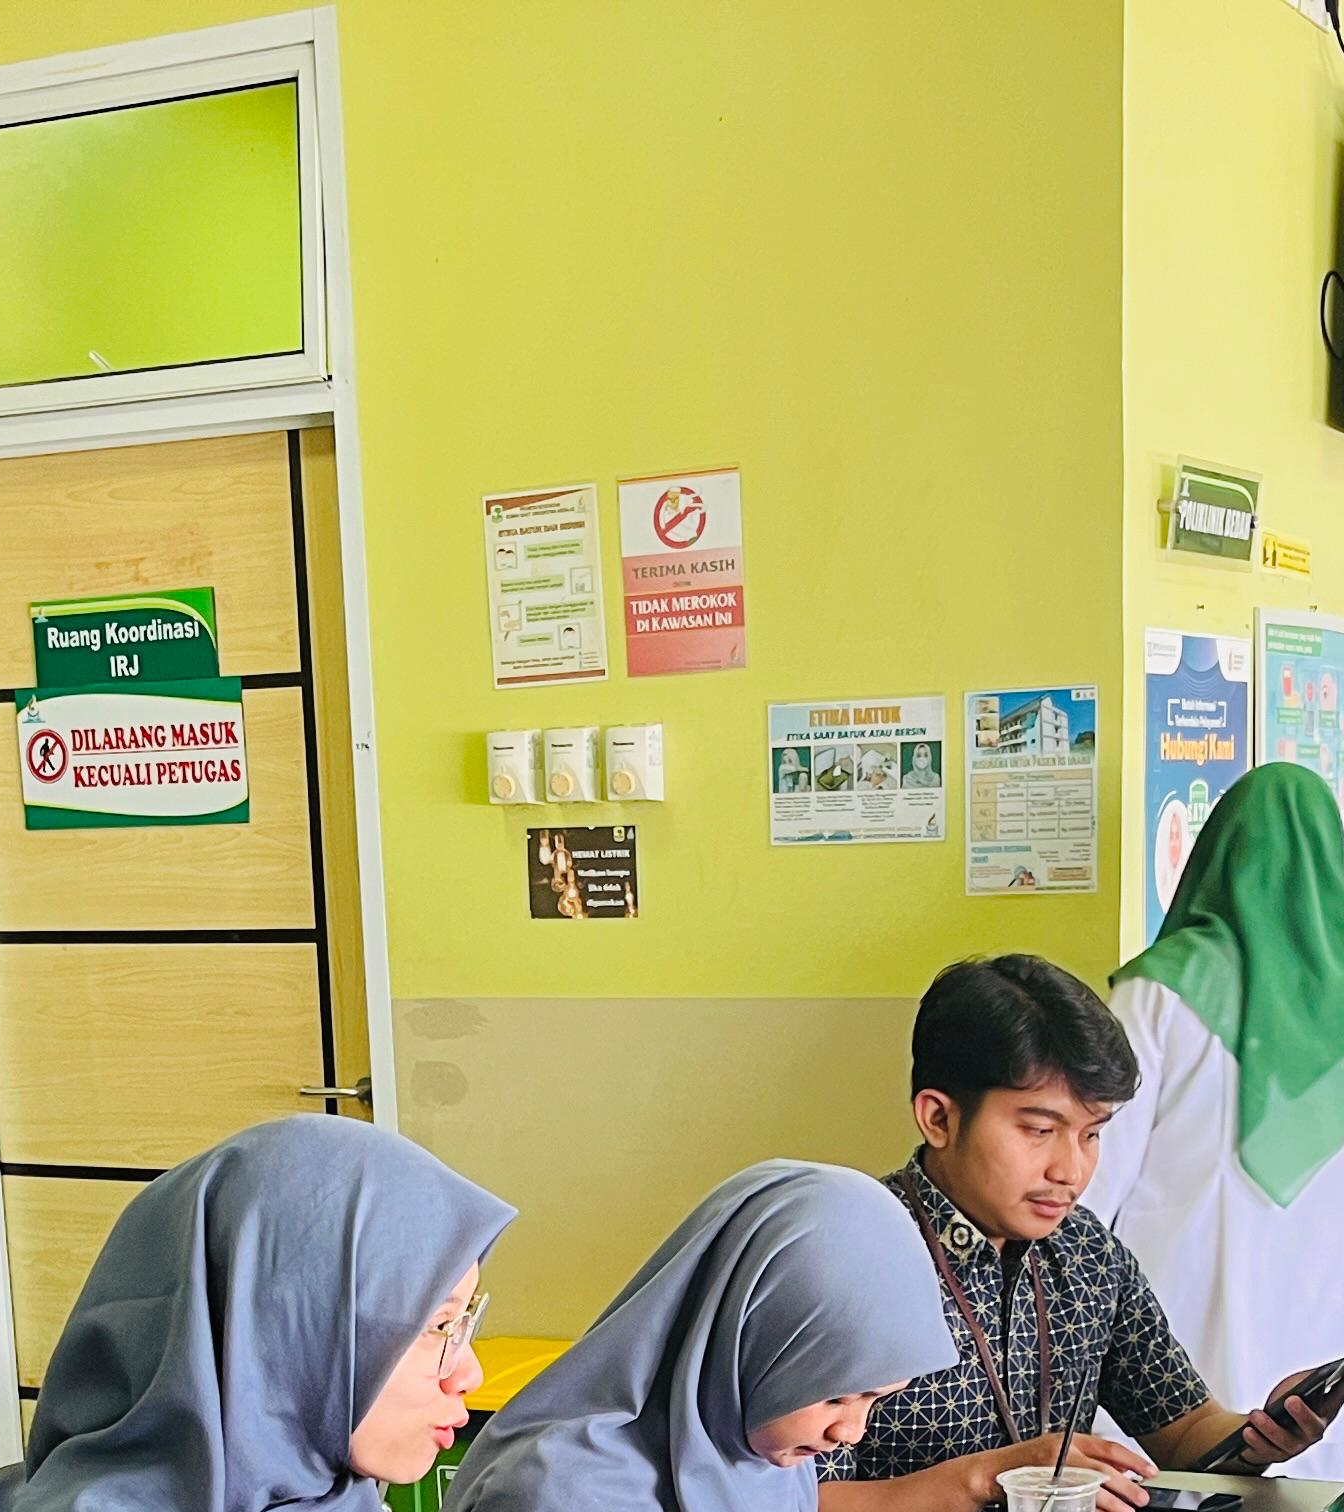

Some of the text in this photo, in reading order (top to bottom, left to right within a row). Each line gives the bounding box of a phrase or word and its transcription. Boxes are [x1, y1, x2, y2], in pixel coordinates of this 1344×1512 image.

[632, 559, 735, 579] TERIMA KASIH
[630, 592, 736, 615] TIDAK MEROKOK
[636, 611, 732, 633] DI KAWASAN INI
[47, 619, 200, 651] Ruang Koordinasi
[110, 654, 140, 677] IRJ
[809, 706, 903, 727] ETIKA BATUK
[71, 721, 239, 752] DILARANG MASUK
[73, 759, 241, 788] KECUALI PETUGAS
